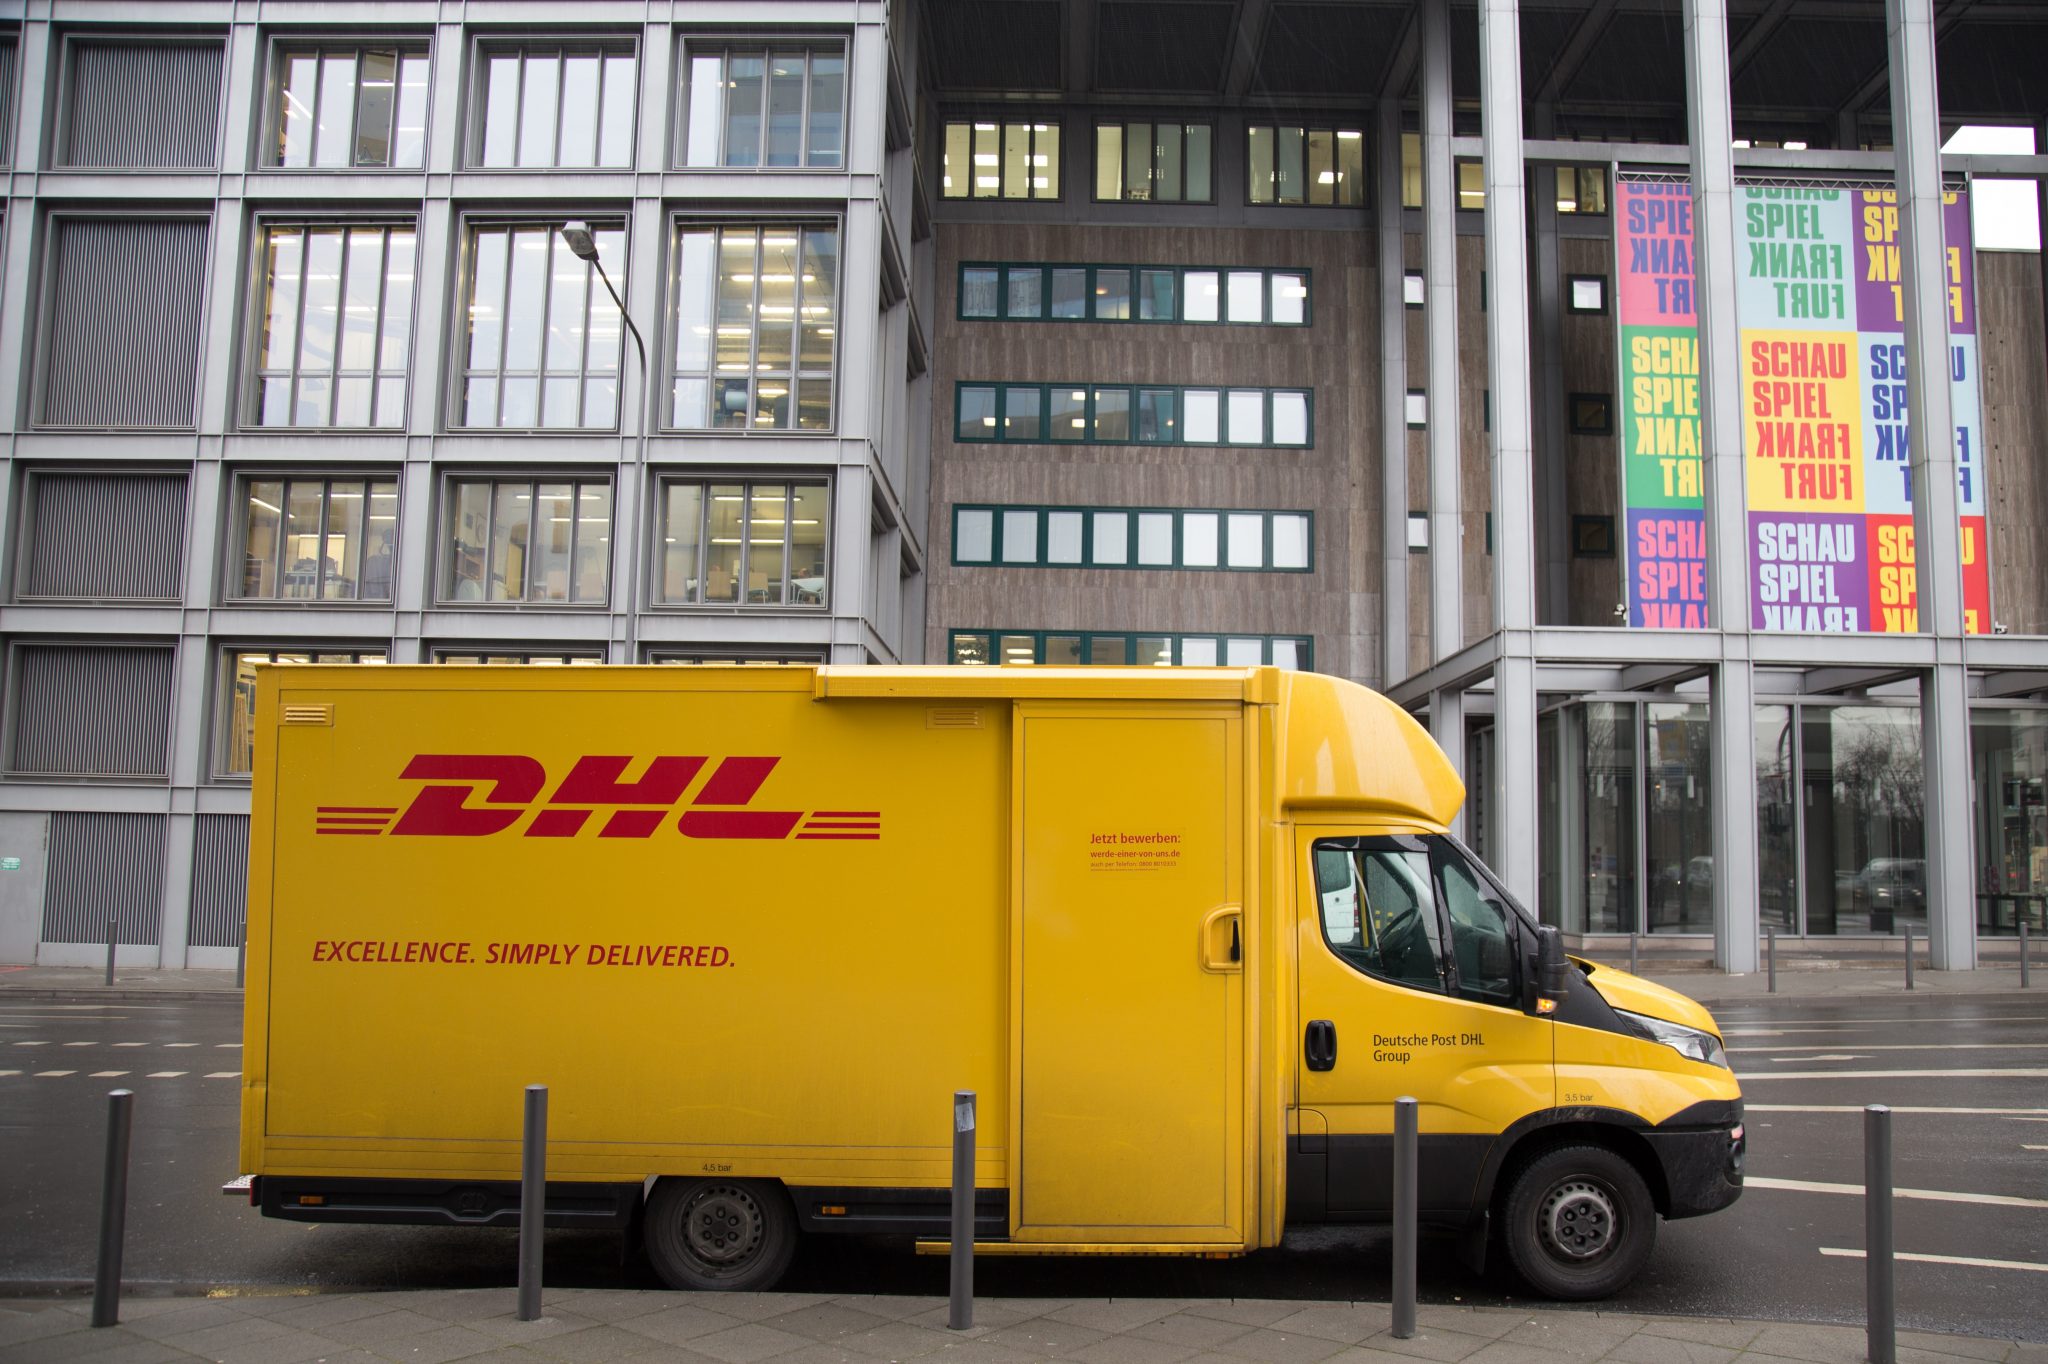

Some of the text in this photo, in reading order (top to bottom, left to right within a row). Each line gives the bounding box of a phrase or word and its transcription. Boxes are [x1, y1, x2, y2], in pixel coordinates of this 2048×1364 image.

[1628, 199, 1691, 235] SPIE
[1746, 203, 1824, 239] SPIEL
[1751, 341, 1846, 378] SCHAU
[1633, 376, 1698, 415] SPIE
[1753, 381, 1832, 419] SPIEL
[1758, 522, 1855, 562] SCHAU
[1639, 561, 1704, 600] SPIE
[1760, 563, 1840, 603] SPIEL
[388, 754, 804, 840] DHL
[1090, 832, 1181, 844] Jetzt bewerben:
[1090, 849, 1181, 858] werde-einer-von-uns.de
[312, 941, 736, 967] EXCELLENCE. SIMPLY DELIVERED.
[1373, 1033, 1485, 1046] Deutsche Post DHL
[1373, 1049, 1411, 1065] Group
[1565, 1093, 1593, 1102] 3,5 bar
[703, 1163, 732, 1172] 4,5 bar
